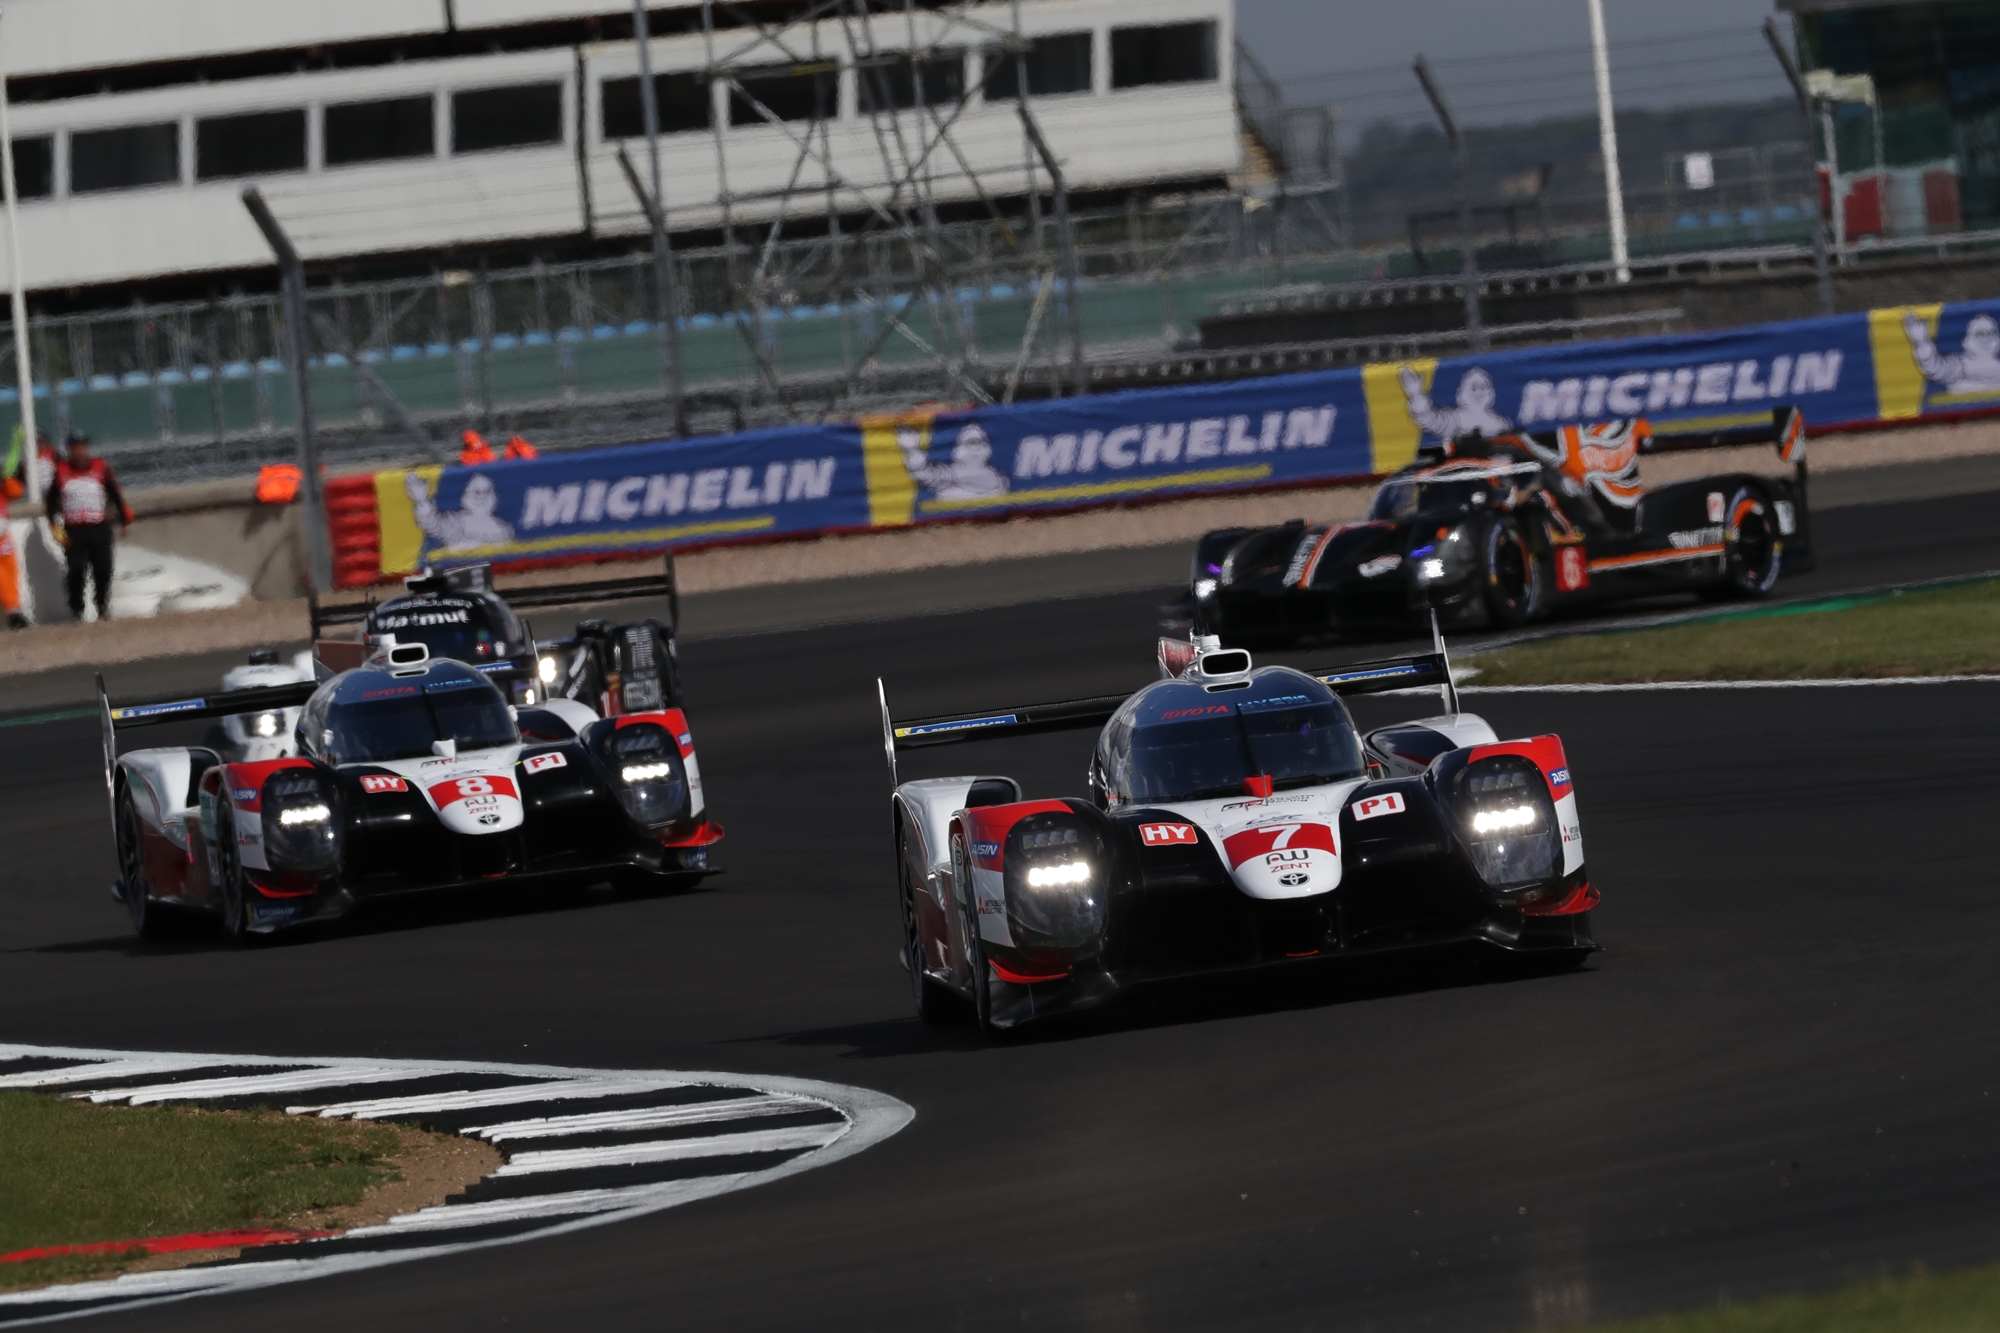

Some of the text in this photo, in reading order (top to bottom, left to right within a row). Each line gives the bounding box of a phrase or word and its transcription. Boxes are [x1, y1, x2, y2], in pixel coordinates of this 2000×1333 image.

[1517, 349, 1843, 424] MICHELIN
[1013, 402, 1338, 480] MICHELIN
[520, 456, 837, 530] MICHELIN
[361, 685, 416, 699] TOYOTA
[1160, 705, 1228, 721] TOYOTA
[531, 754, 560, 769] P1
[365, 776, 401, 789] HY
[455, 776, 494, 797] 8
[467, 805, 501, 815] ZENT
[1359, 795, 1397, 816] P1
[1146, 825, 1189, 842] HY
[1258, 824, 1302, 851] 7
[971, 844, 998, 856] AISIN
[1269, 861, 1313, 873] ZENT
